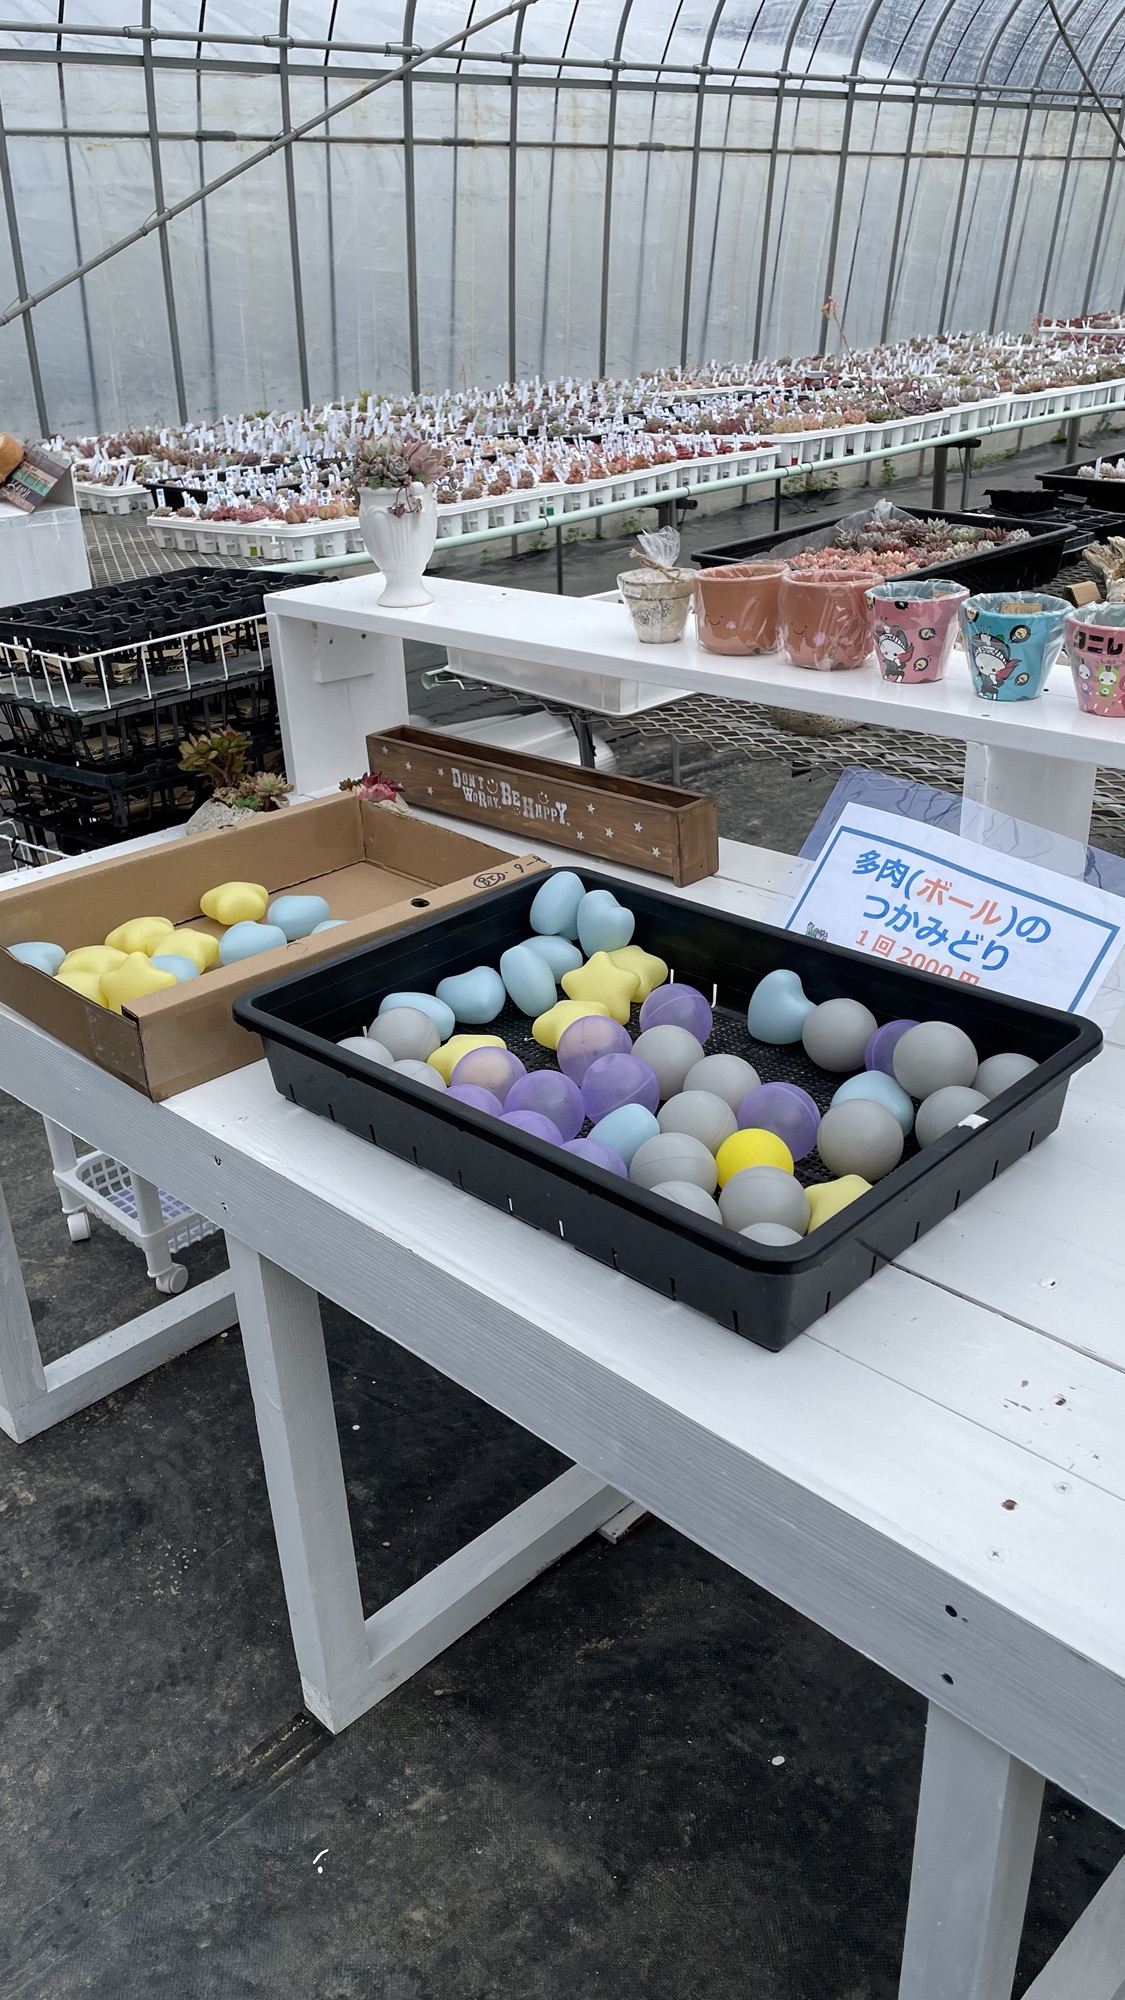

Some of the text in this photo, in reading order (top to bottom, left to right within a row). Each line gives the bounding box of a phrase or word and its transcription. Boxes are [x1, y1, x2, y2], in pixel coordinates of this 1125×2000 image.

[451, 767, 484, 789] DON'T
[500, 781, 521, 807] BE
[852, 849, 1051, 944] 多肉(ボール)の
[862, 894, 1010, 971] つかみどり
